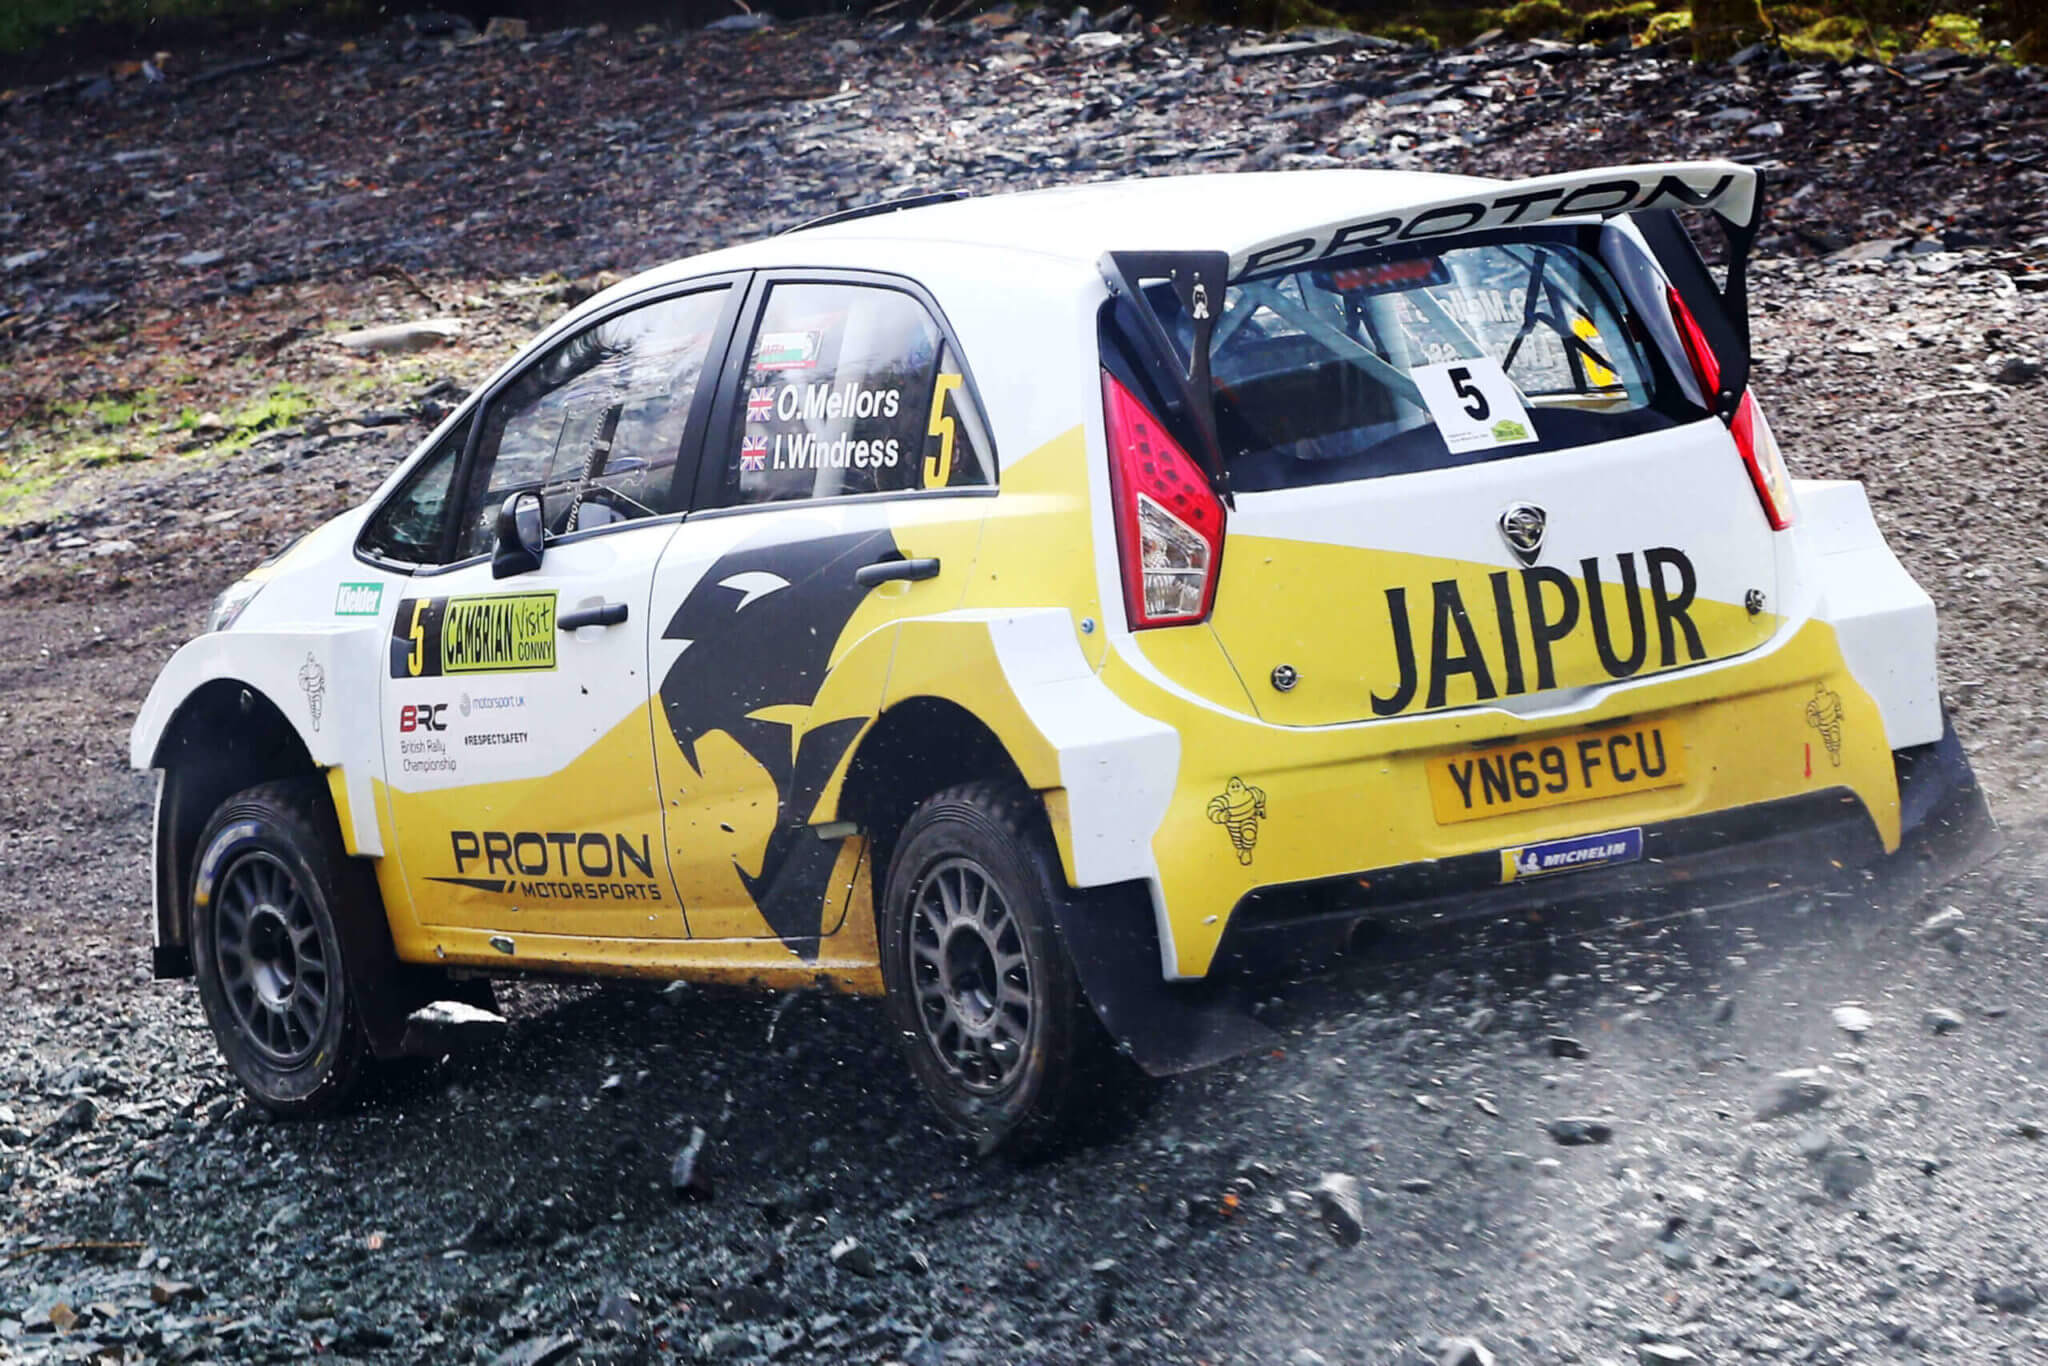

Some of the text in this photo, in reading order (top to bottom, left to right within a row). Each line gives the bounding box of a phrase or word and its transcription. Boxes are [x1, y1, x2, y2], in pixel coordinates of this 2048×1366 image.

[1232, 174, 1735, 282] PROTON
[777, 382, 899, 421] O.Mellors
[1447, 367, 1490, 421] 5
[773, 431, 899, 470] I.Windress
[923, 374, 963, 489] 5
[407, 597, 431, 677] 5
[445, 604, 515, 666] CAMBRIAN
[515, 606, 550, 640] Visit
[1369, 546, 1708, 716] JAIPUR
[518, 641, 552, 662] CONWY
[400, 703, 448, 732] BRC
[472, 696, 513, 710] motorsport
[401, 738, 446, 755] British Rally
[464, 732, 528, 747] #RESPECTSAFETY
[403, 757, 457, 774] Championship
[1448, 729, 1667, 809] YN69 FCU
[451, 830, 655, 879] PROTON
[1544, 842, 1627, 867] MICHELIN
[521, 882, 663, 901] MOTORSPORTS
